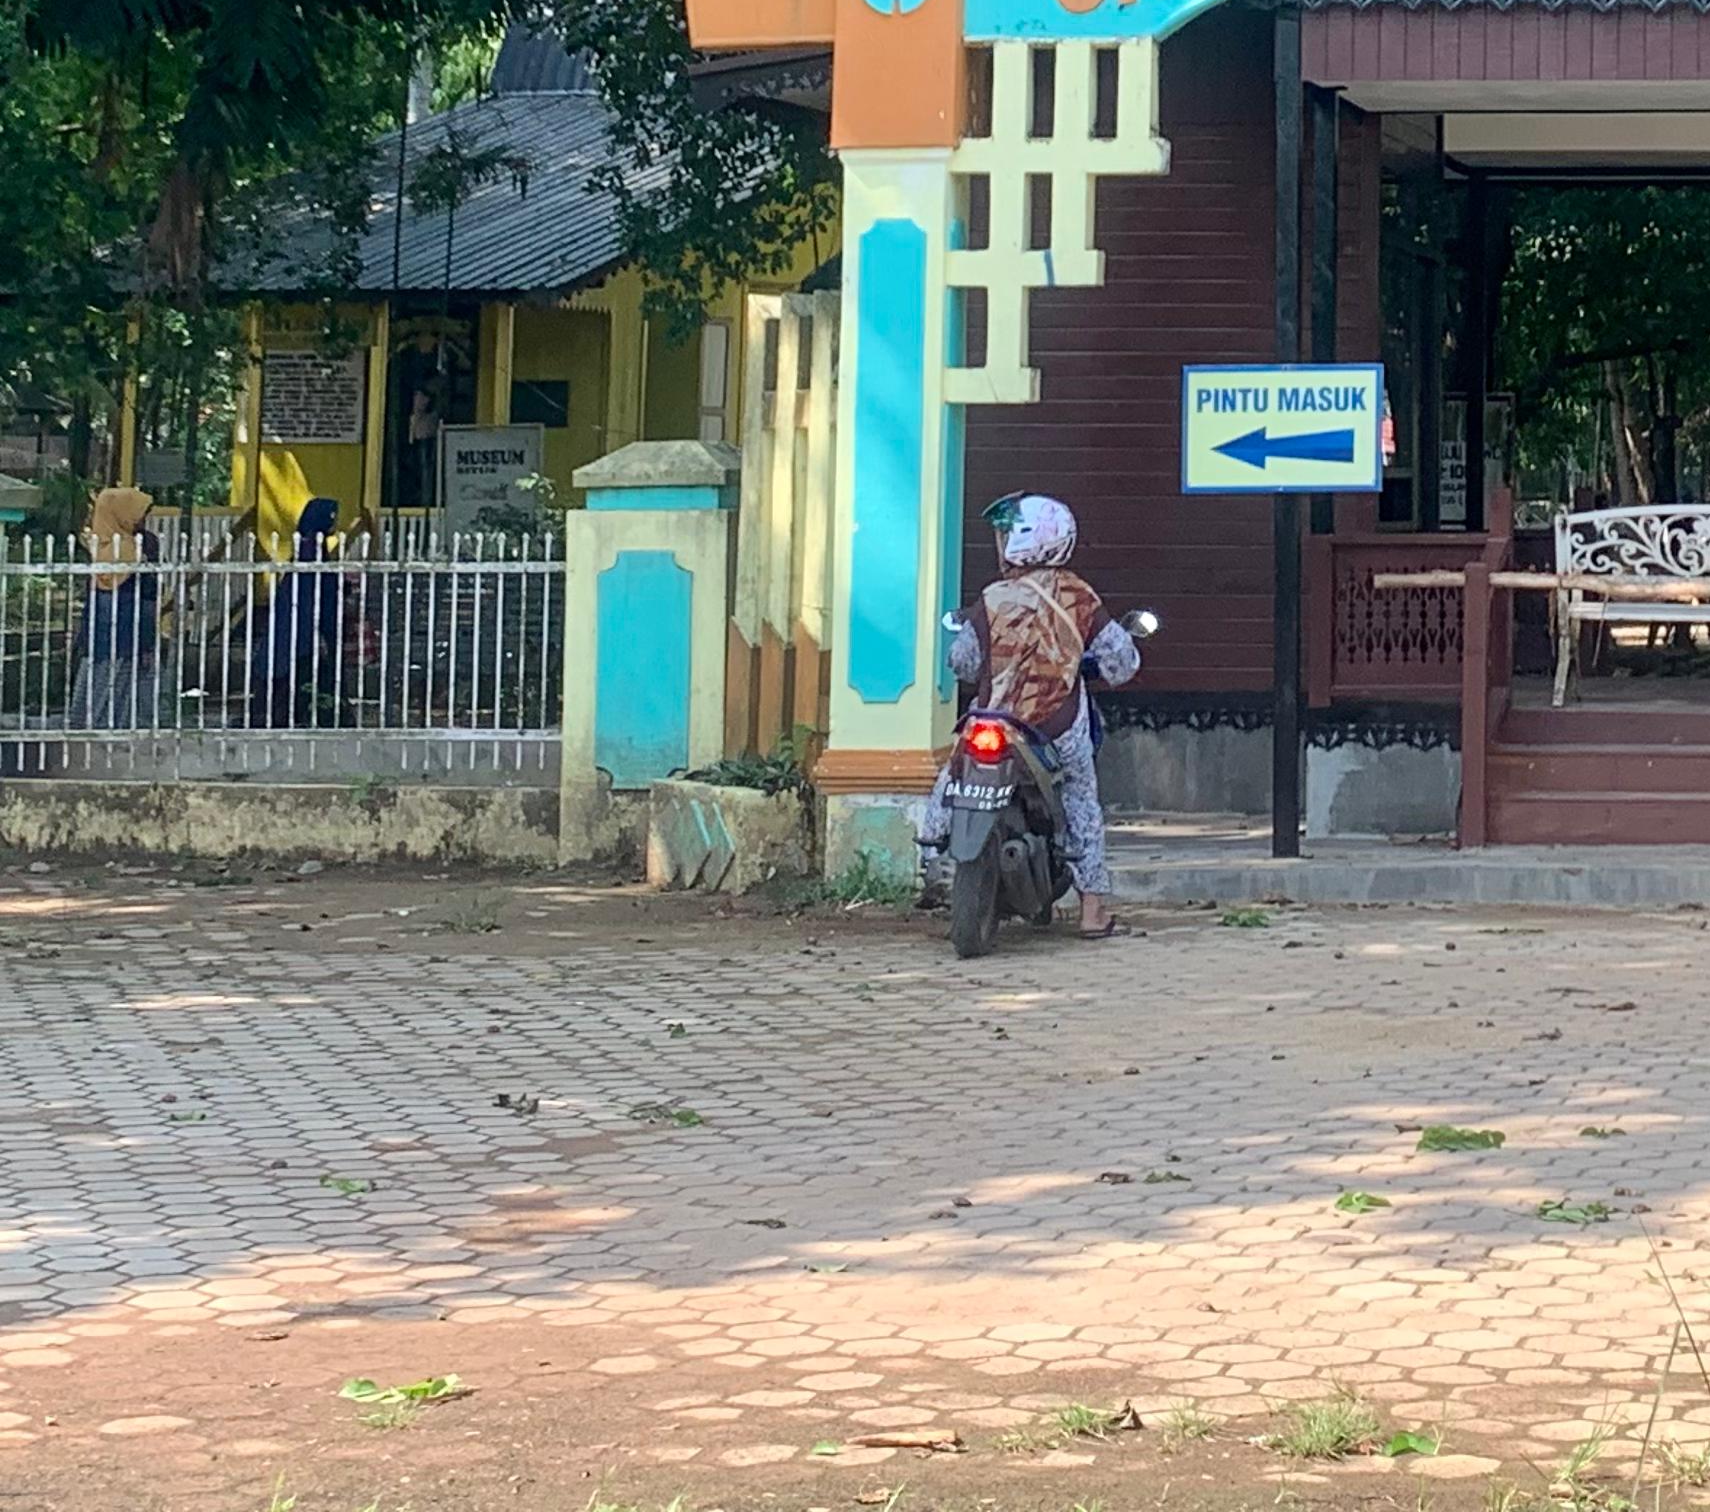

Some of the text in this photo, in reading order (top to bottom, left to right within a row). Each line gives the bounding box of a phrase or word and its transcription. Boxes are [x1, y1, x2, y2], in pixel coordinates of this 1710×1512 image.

[1197, 387, 1367, 413] PINTU MASUK
[456, 449, 526, 465] MUSEUM
